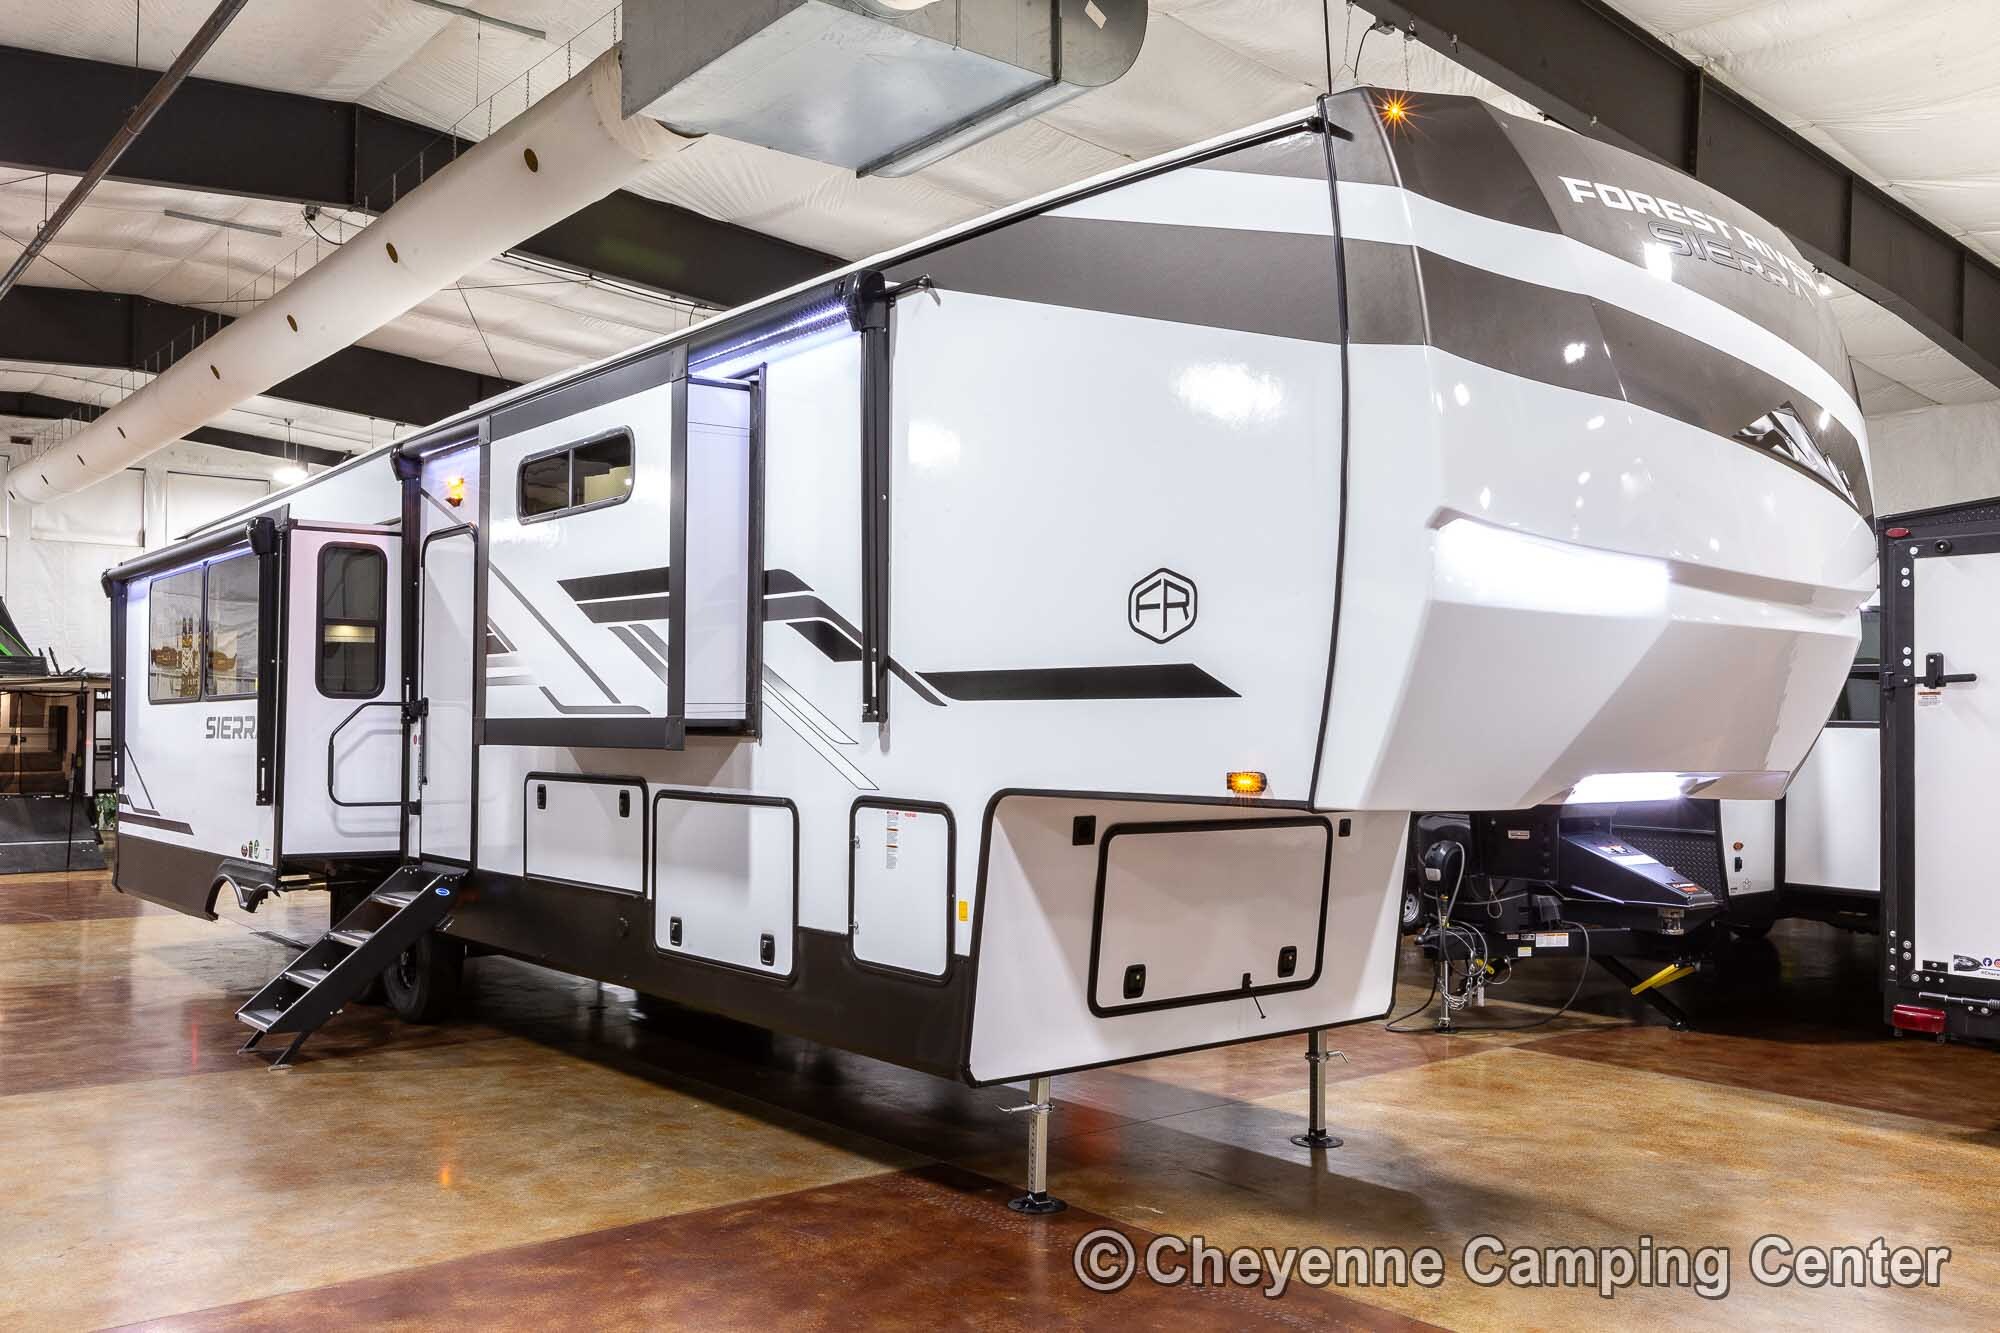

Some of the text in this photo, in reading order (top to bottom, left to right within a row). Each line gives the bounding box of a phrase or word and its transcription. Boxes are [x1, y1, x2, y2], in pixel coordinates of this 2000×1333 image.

[1558, 175, 1732, 241] FOREST
[1648, 221, 1816, 308] SIERRA
[205, 716, 257, 740] SIERR
